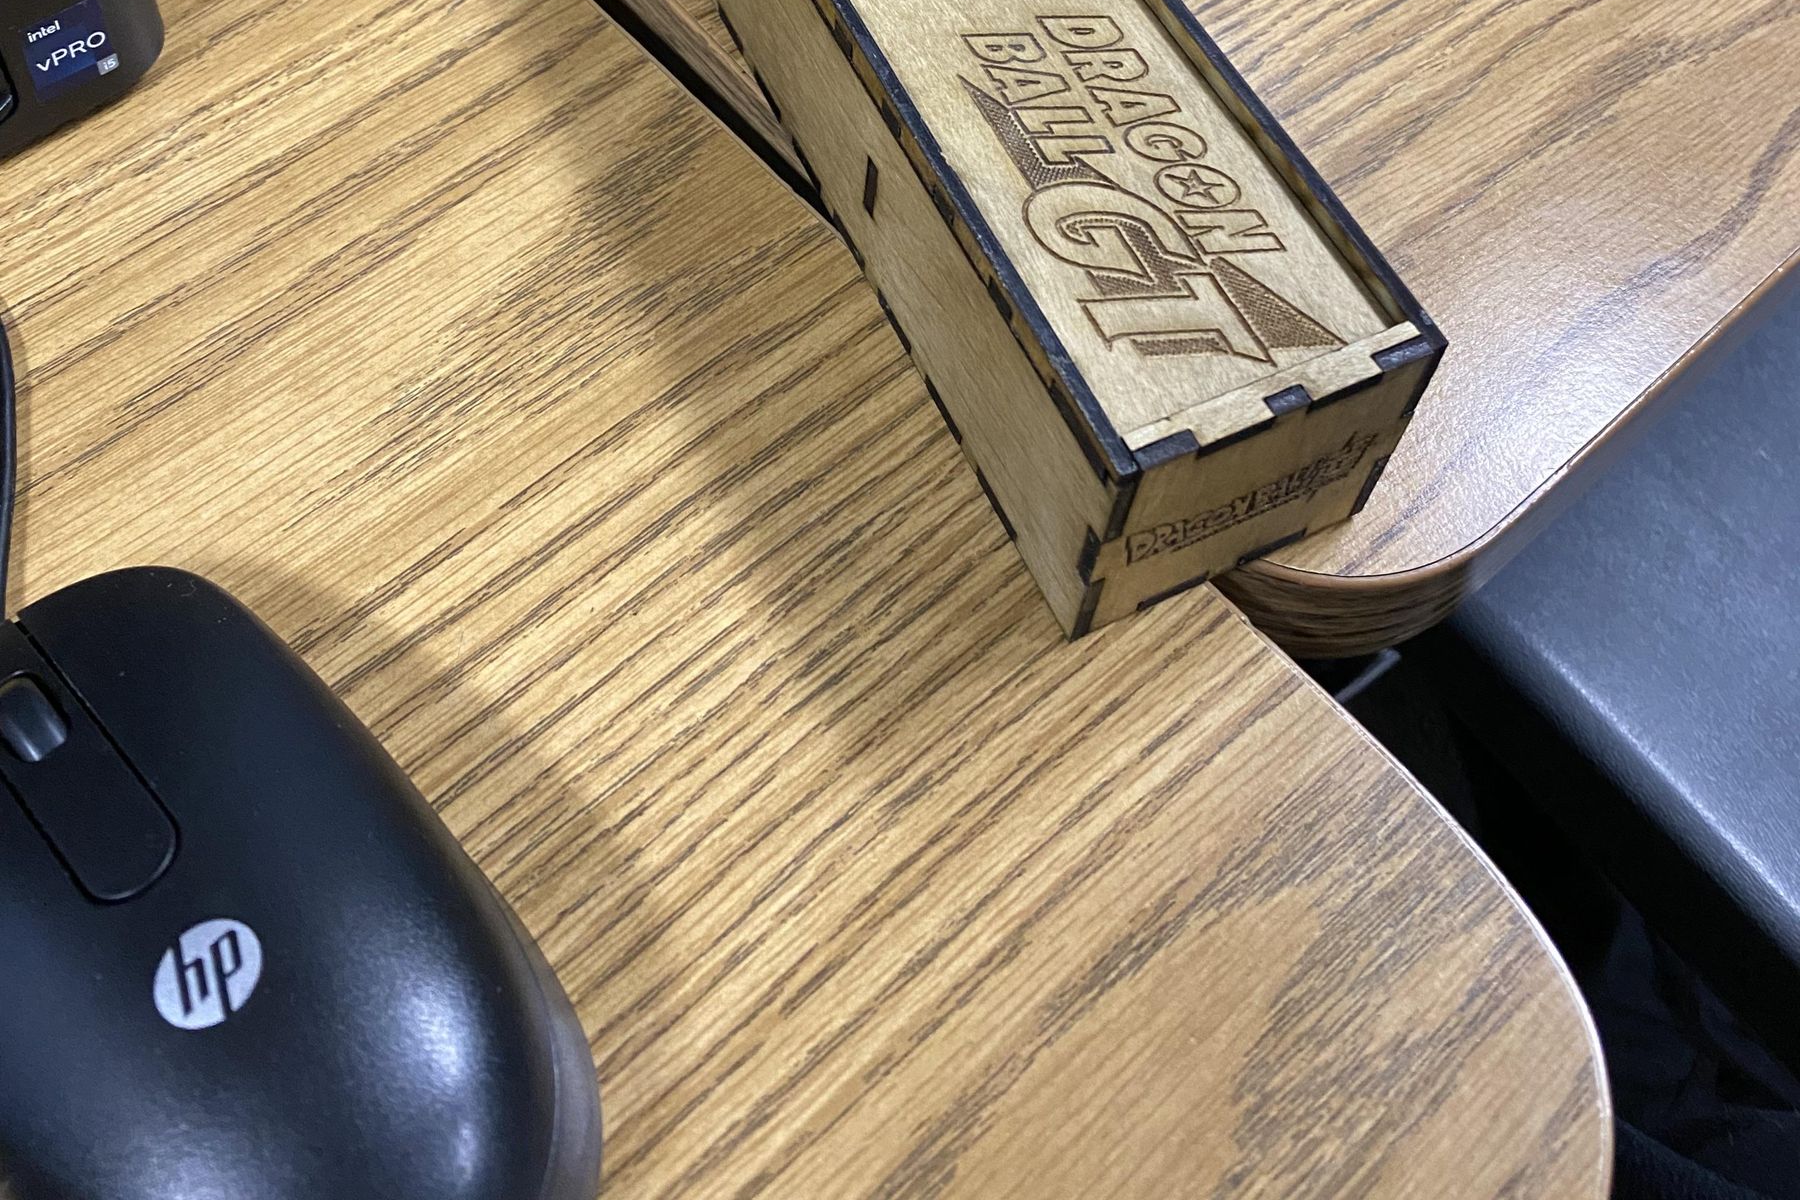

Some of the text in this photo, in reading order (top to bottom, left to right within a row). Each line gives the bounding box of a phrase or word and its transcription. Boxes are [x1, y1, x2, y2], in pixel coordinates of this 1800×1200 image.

[27, 20, 61, 43] intel
[36, 31, 106, 72] vPRO
[103, 59, 116, 71] i5
[960, 32, 1116, 168] BALL
[1036, 15, 1287, 255] DRAGON
[1021, 181, 1277, 367] GT
[163, 924, 252, 1026] hp
